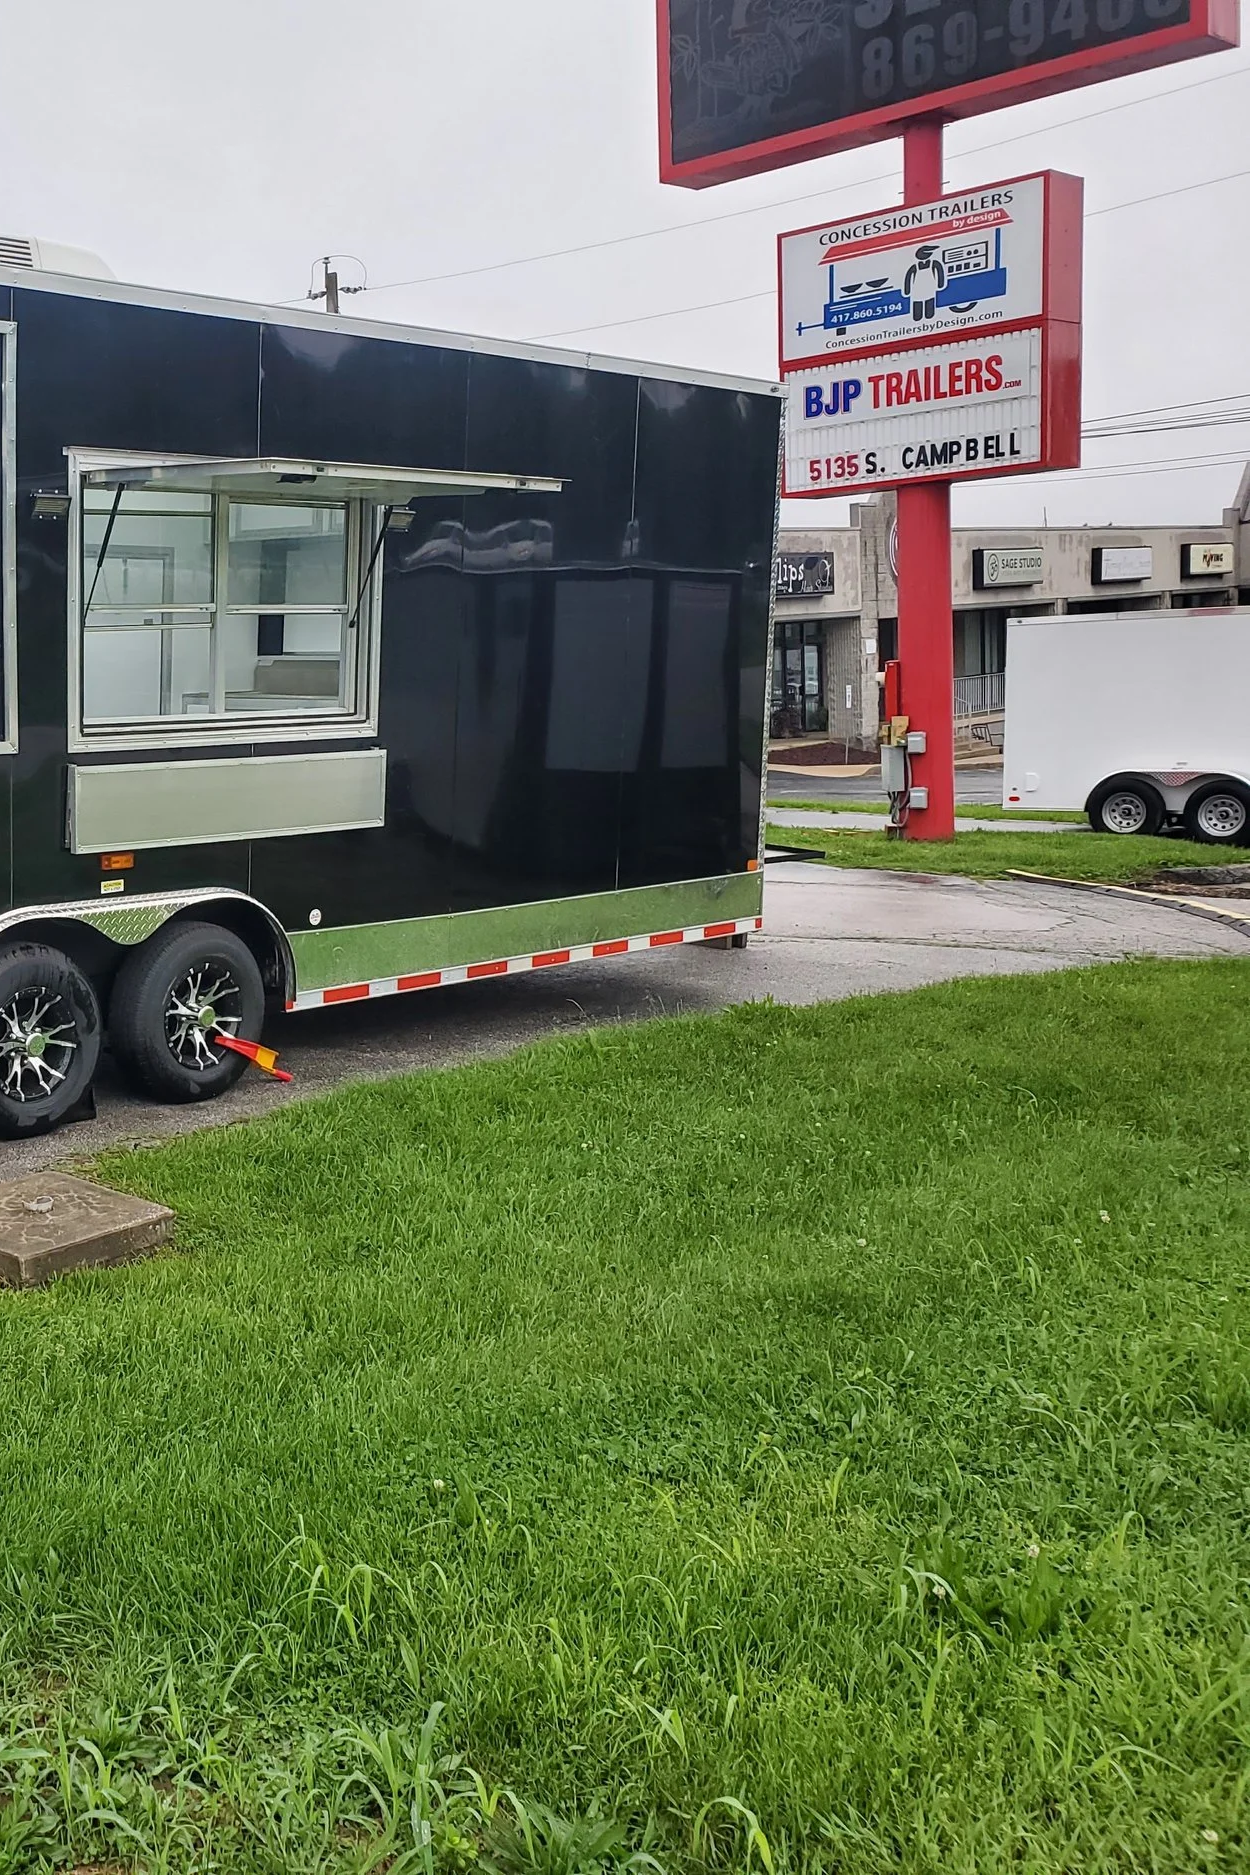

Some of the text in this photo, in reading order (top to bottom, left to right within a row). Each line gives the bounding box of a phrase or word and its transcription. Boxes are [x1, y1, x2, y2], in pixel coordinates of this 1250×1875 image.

[819, 190, 1014, 246] CONCESSION TRAILERS
[952, 210, 1002, 229] by design
[825, 309, 1003, 350] ConcessionTrailersbyDesign.com
[830, 302, 903, 324] 417.860.5194
[803, 378, 863, 420] BJP
[809, 432, 1021, 482] 5135 S. CAMPBELL
[775, 557, 804, 593] lips
[1001, 556, 1042, 569] SAGE STUDIO
